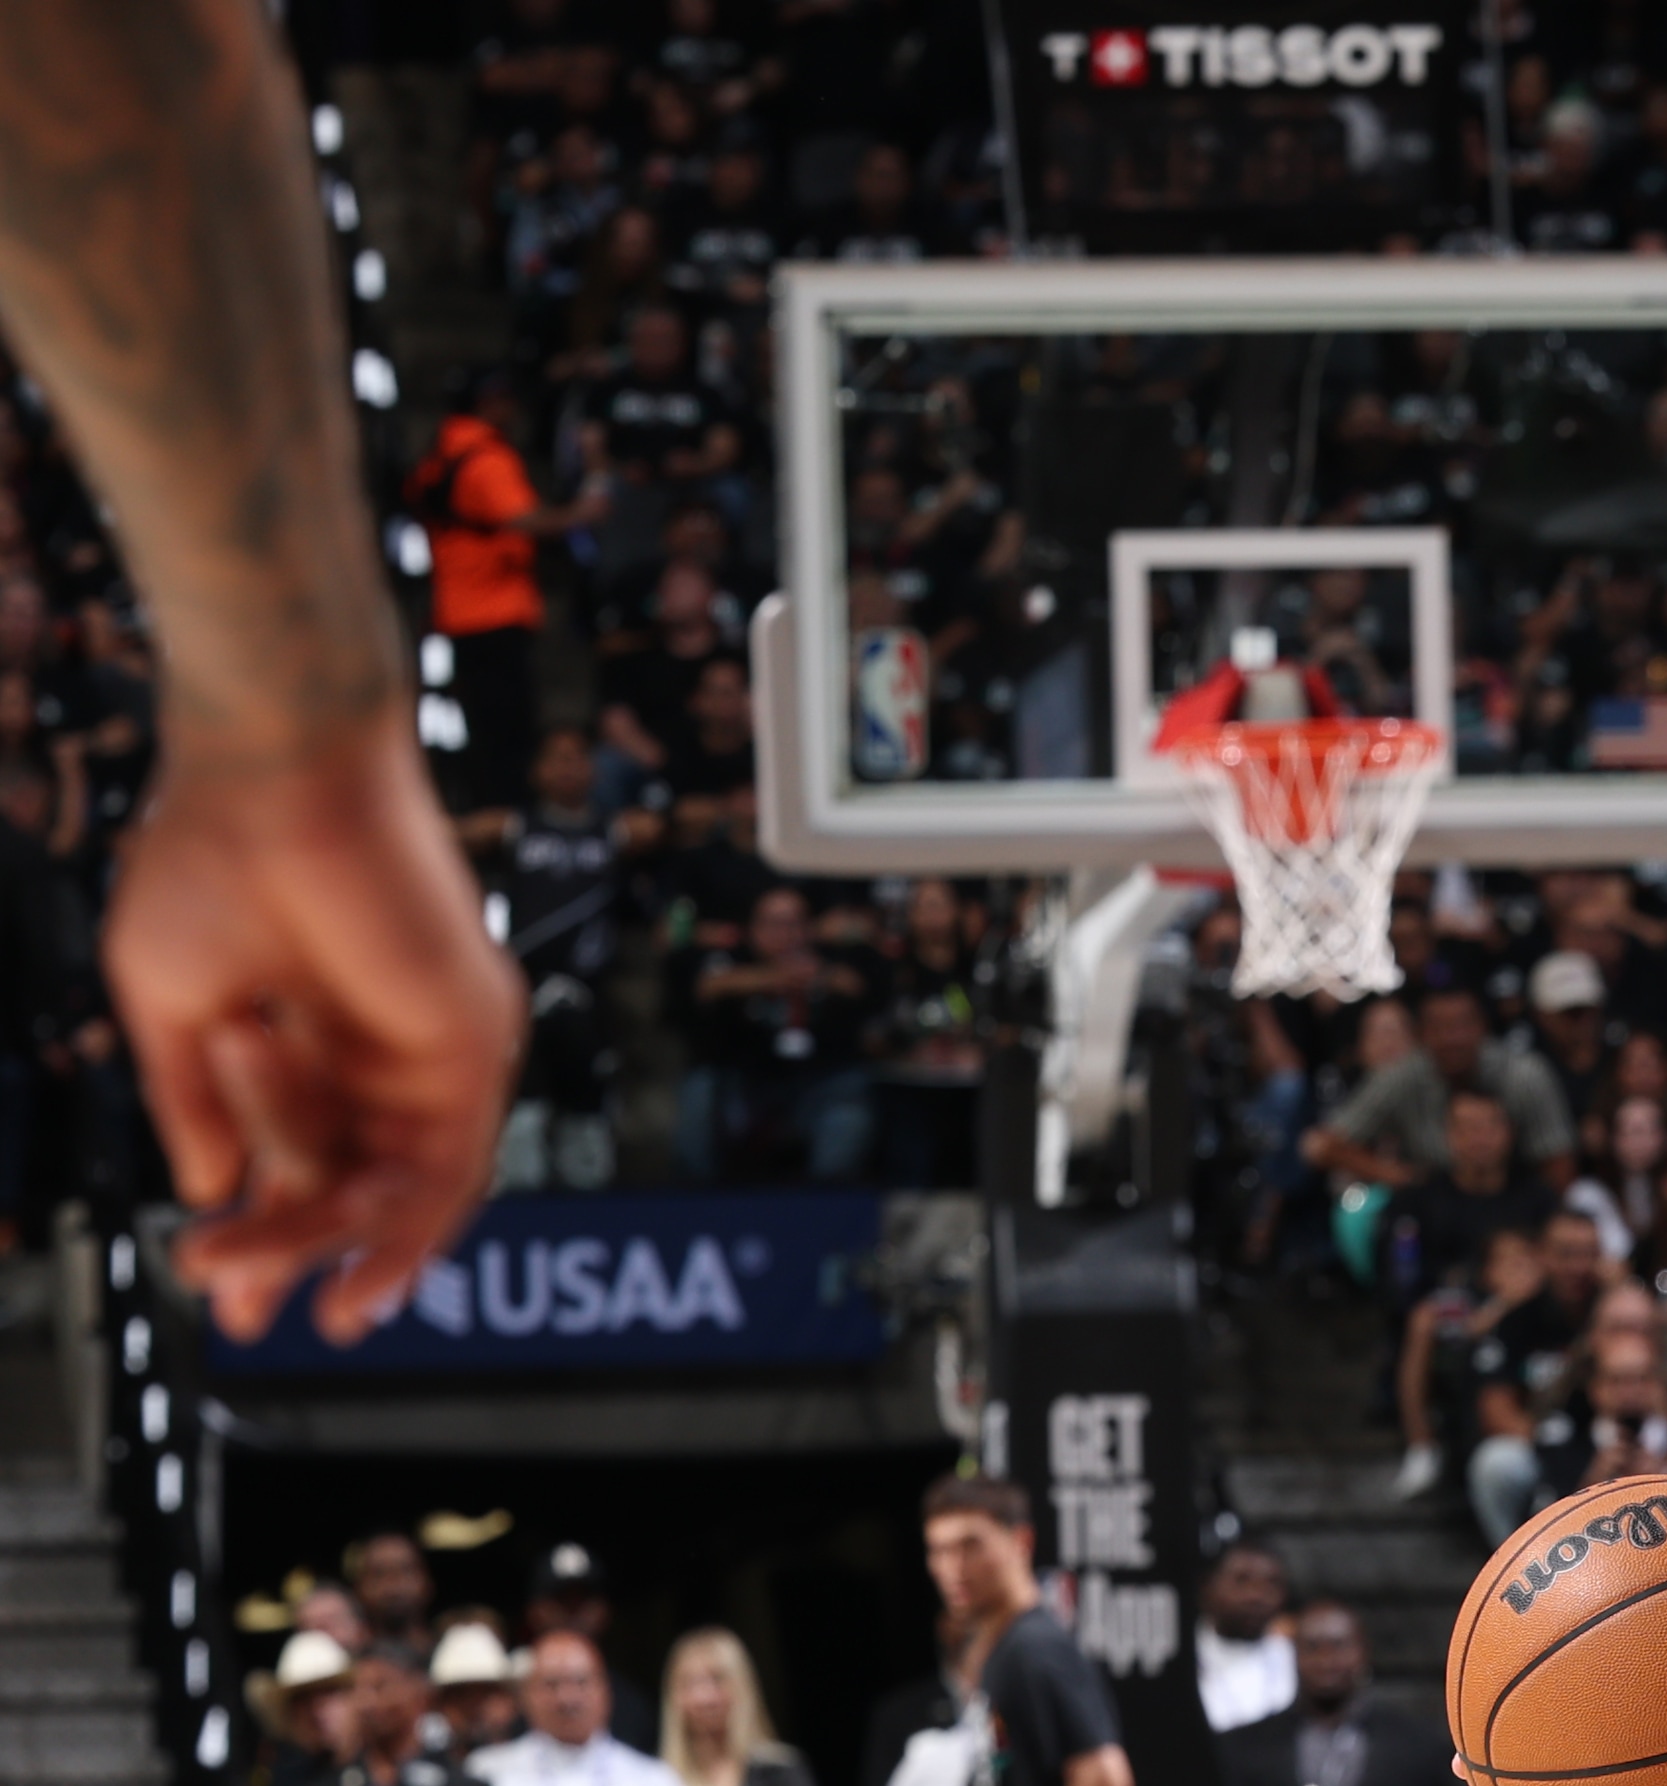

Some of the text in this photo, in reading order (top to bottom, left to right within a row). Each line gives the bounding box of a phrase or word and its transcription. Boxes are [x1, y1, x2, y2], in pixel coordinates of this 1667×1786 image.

[1149, 23, 1442, 89] TISSOT
[476, 1236, 746, 1336] USAA
[1050, 1394, 1151, 1479] GET
[1050, 1481, 1155, 1570] THE
